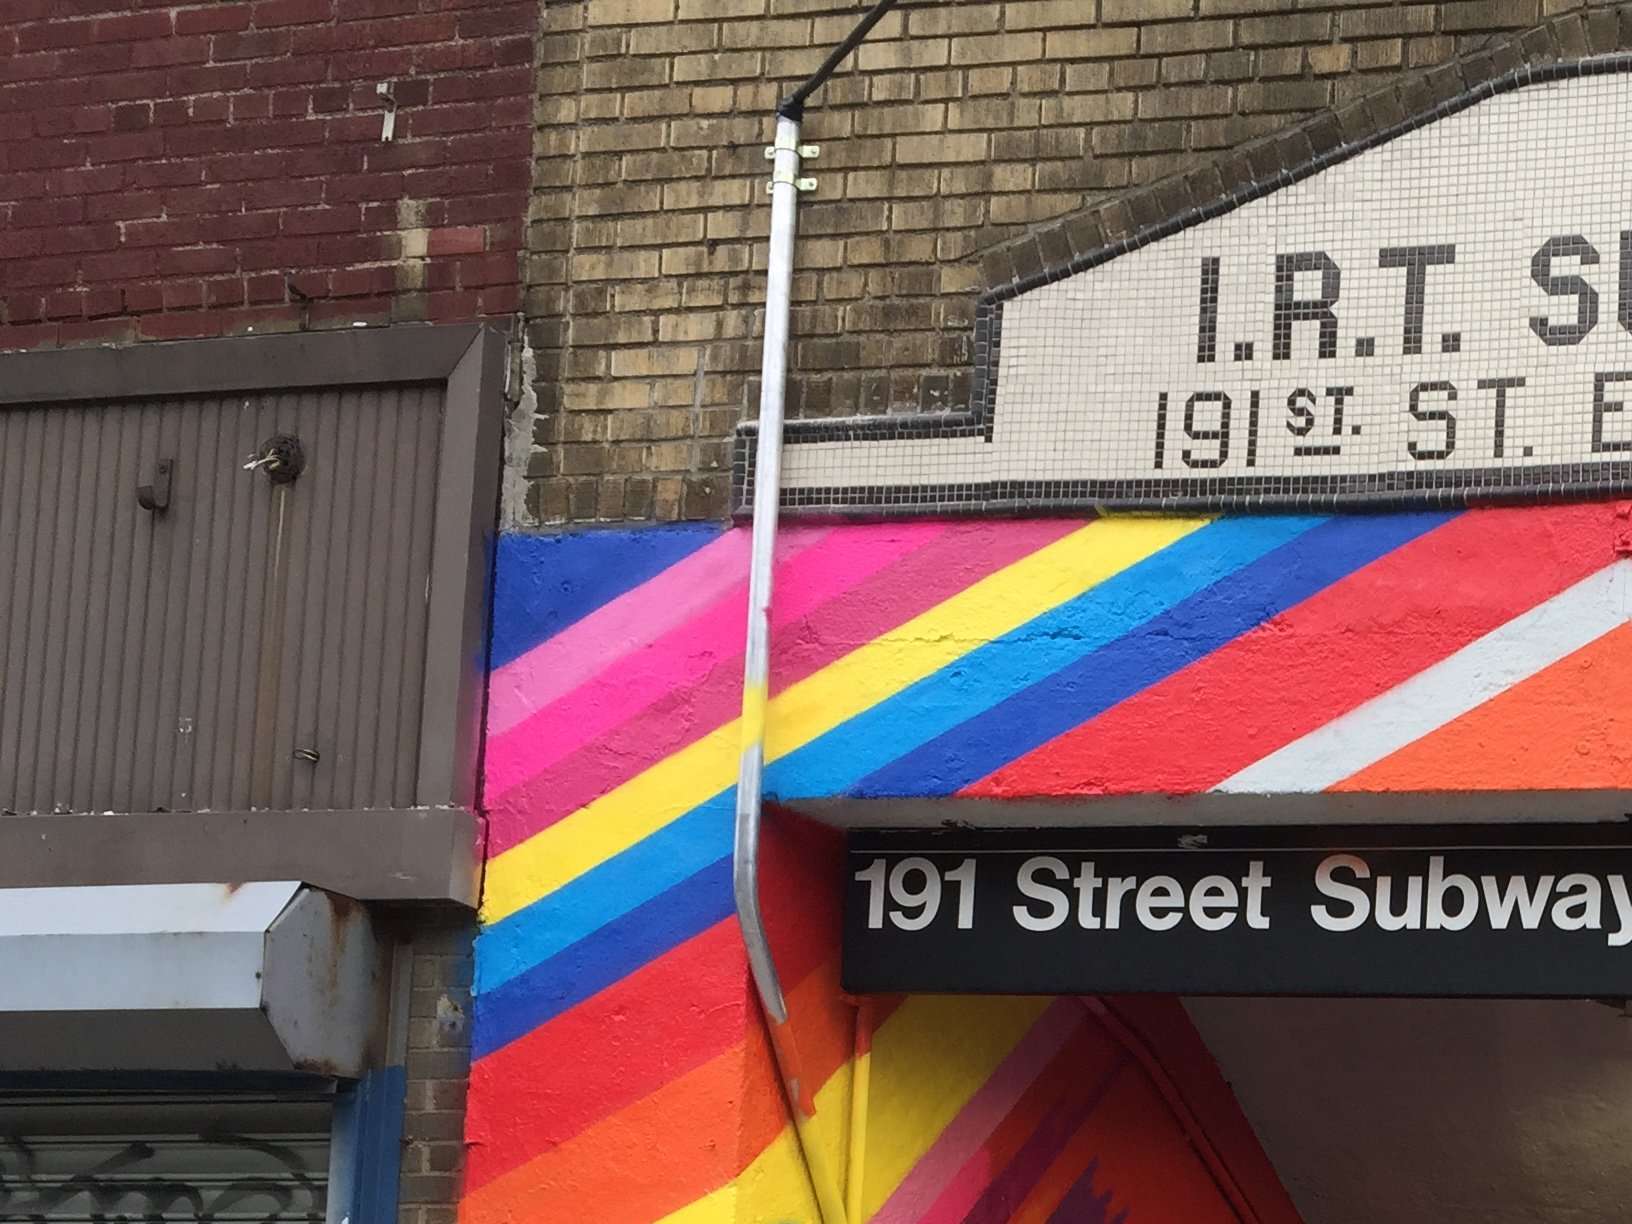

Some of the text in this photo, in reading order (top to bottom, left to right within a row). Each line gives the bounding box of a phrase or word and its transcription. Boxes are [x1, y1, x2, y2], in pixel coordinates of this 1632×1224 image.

[1196, 243, 1461, 363] I.R.T.
[1407, 377, 1533, 460] ST.
[854, 856, 977, 931] 191
[1012, 855, 1272, 932] Street
